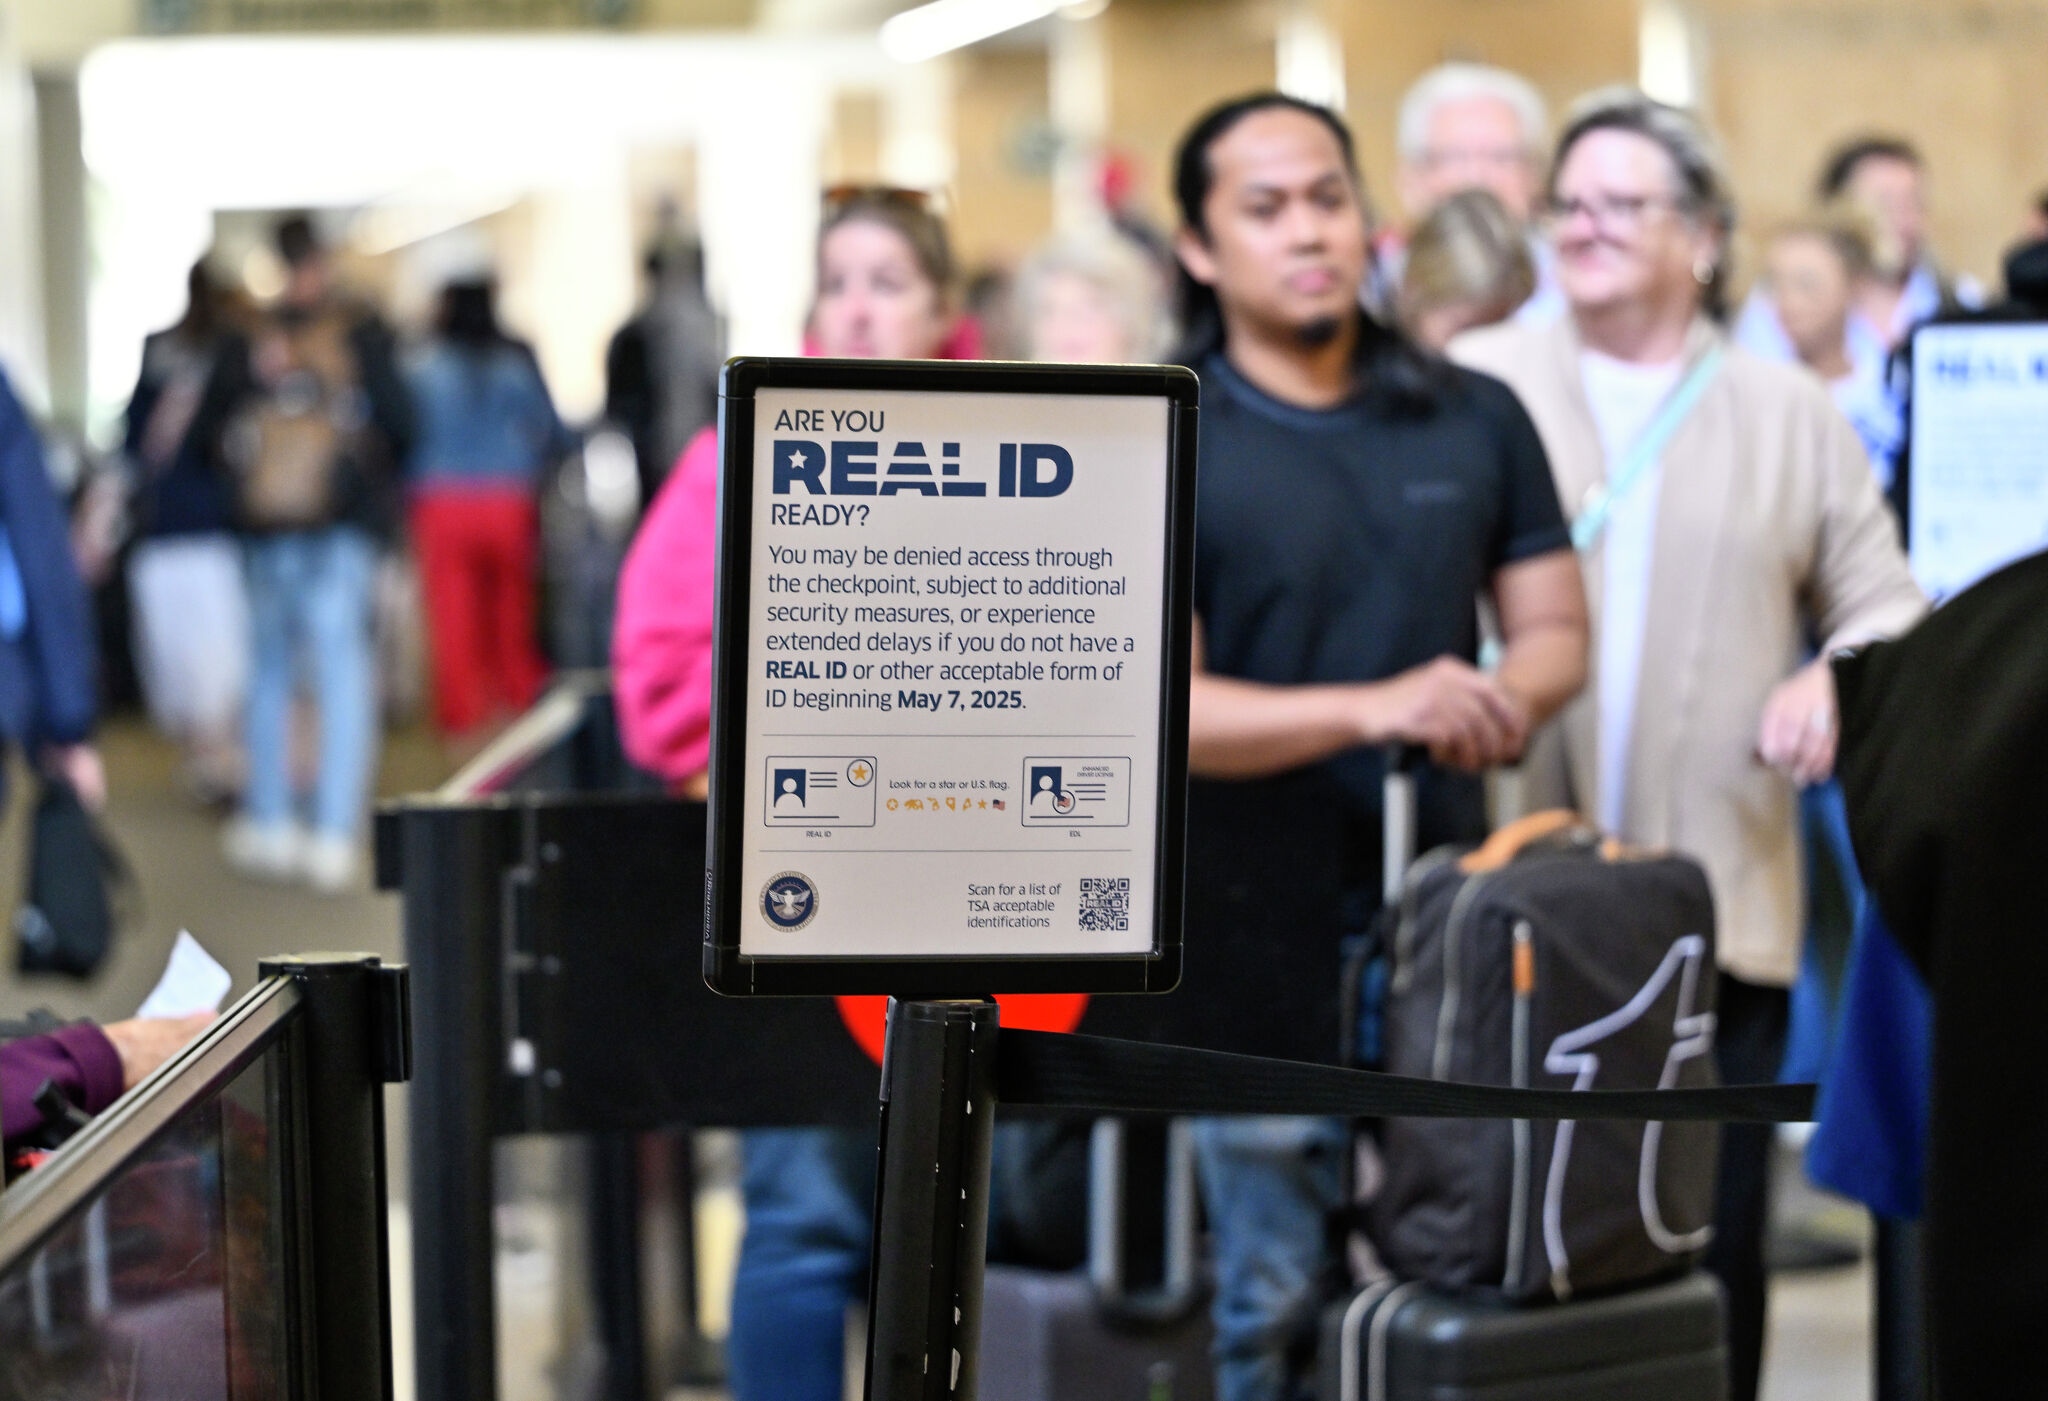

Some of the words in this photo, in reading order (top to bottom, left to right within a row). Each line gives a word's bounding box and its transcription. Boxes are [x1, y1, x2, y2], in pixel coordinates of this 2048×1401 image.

[774, 408, 825, 432] ARE
[830, 409, 885, 433] YOU
[772, 439, 987, 498] REAL
[998, 442, 1074, 498] ID
[771, 503, 871, 527] READY?
[768, 545, 807, 565] You
[813, 549, 858, 569] may
[863, 545, 888, 566] be
[893, 545, 962, 566] denied
[967, 550, 1030, 567] access
[1035, 547, 1113, 571] through
[767, 573, 801, 593] the
[806, 573, 920, 597] checkpoint,
[926, 574, 998, 598] subject
[1002, 576, 1023, 595] to
[1028, 575, 1126, 596] additional
[767, 602, 849, 626] security
[854, 607, 954, 625] measures,
[960, 607, 982, 624] or
[987, 603, 1096, 627] experience
[766, 631, 861, 652] extended
[866, 631, 932, 655] delays
[938, 631, 953, 652] if
[957, 636, 995, 656] you
[1000, 632, 1026, 653] do
[1031, 633, 1064, 653] not
[1070, 632, 1118, 653] have
[1123, 637, 1134, 653] a
[765, 660, 821, 680] REAL
[825, 660, 848, 680] ID
[852, 664, 875, 680] or
[880, 660, 935, 681] other
[939, 660, 1044, 684] acceptable
[1049, 661, 1097, 681] form
[1102, 661, 1124, 681] of
[766, 689, 787, 708] ID
[793, 688, 892, 712] beginning
[897, 689, 943, 713] May
[947, 690, 966, 712] 7,
[970, 689, 1027, 709] 2025.
[889, 780, 912, 789] Look
[914, 780, 926, 789] for
[928, 781, 937, 789] a
[938, 780, 957, 789] star
[958, 781, 969, 789] or
[971, 780, 987, 790] U.S.
[989, 780, 1010, 791] flag.
[968, 883, 995, 896] Scan
[998, 883, 1015, 896] for
[1018, 886, 1026, 896] a
[1029, 883, 1046, 896] list
[1048, 883, 1062, 896] of
[968, 900, 990, 912] TSA
[993, 900, 1055, 913] acceptable
[967, 916, 1050, 928] identifications
